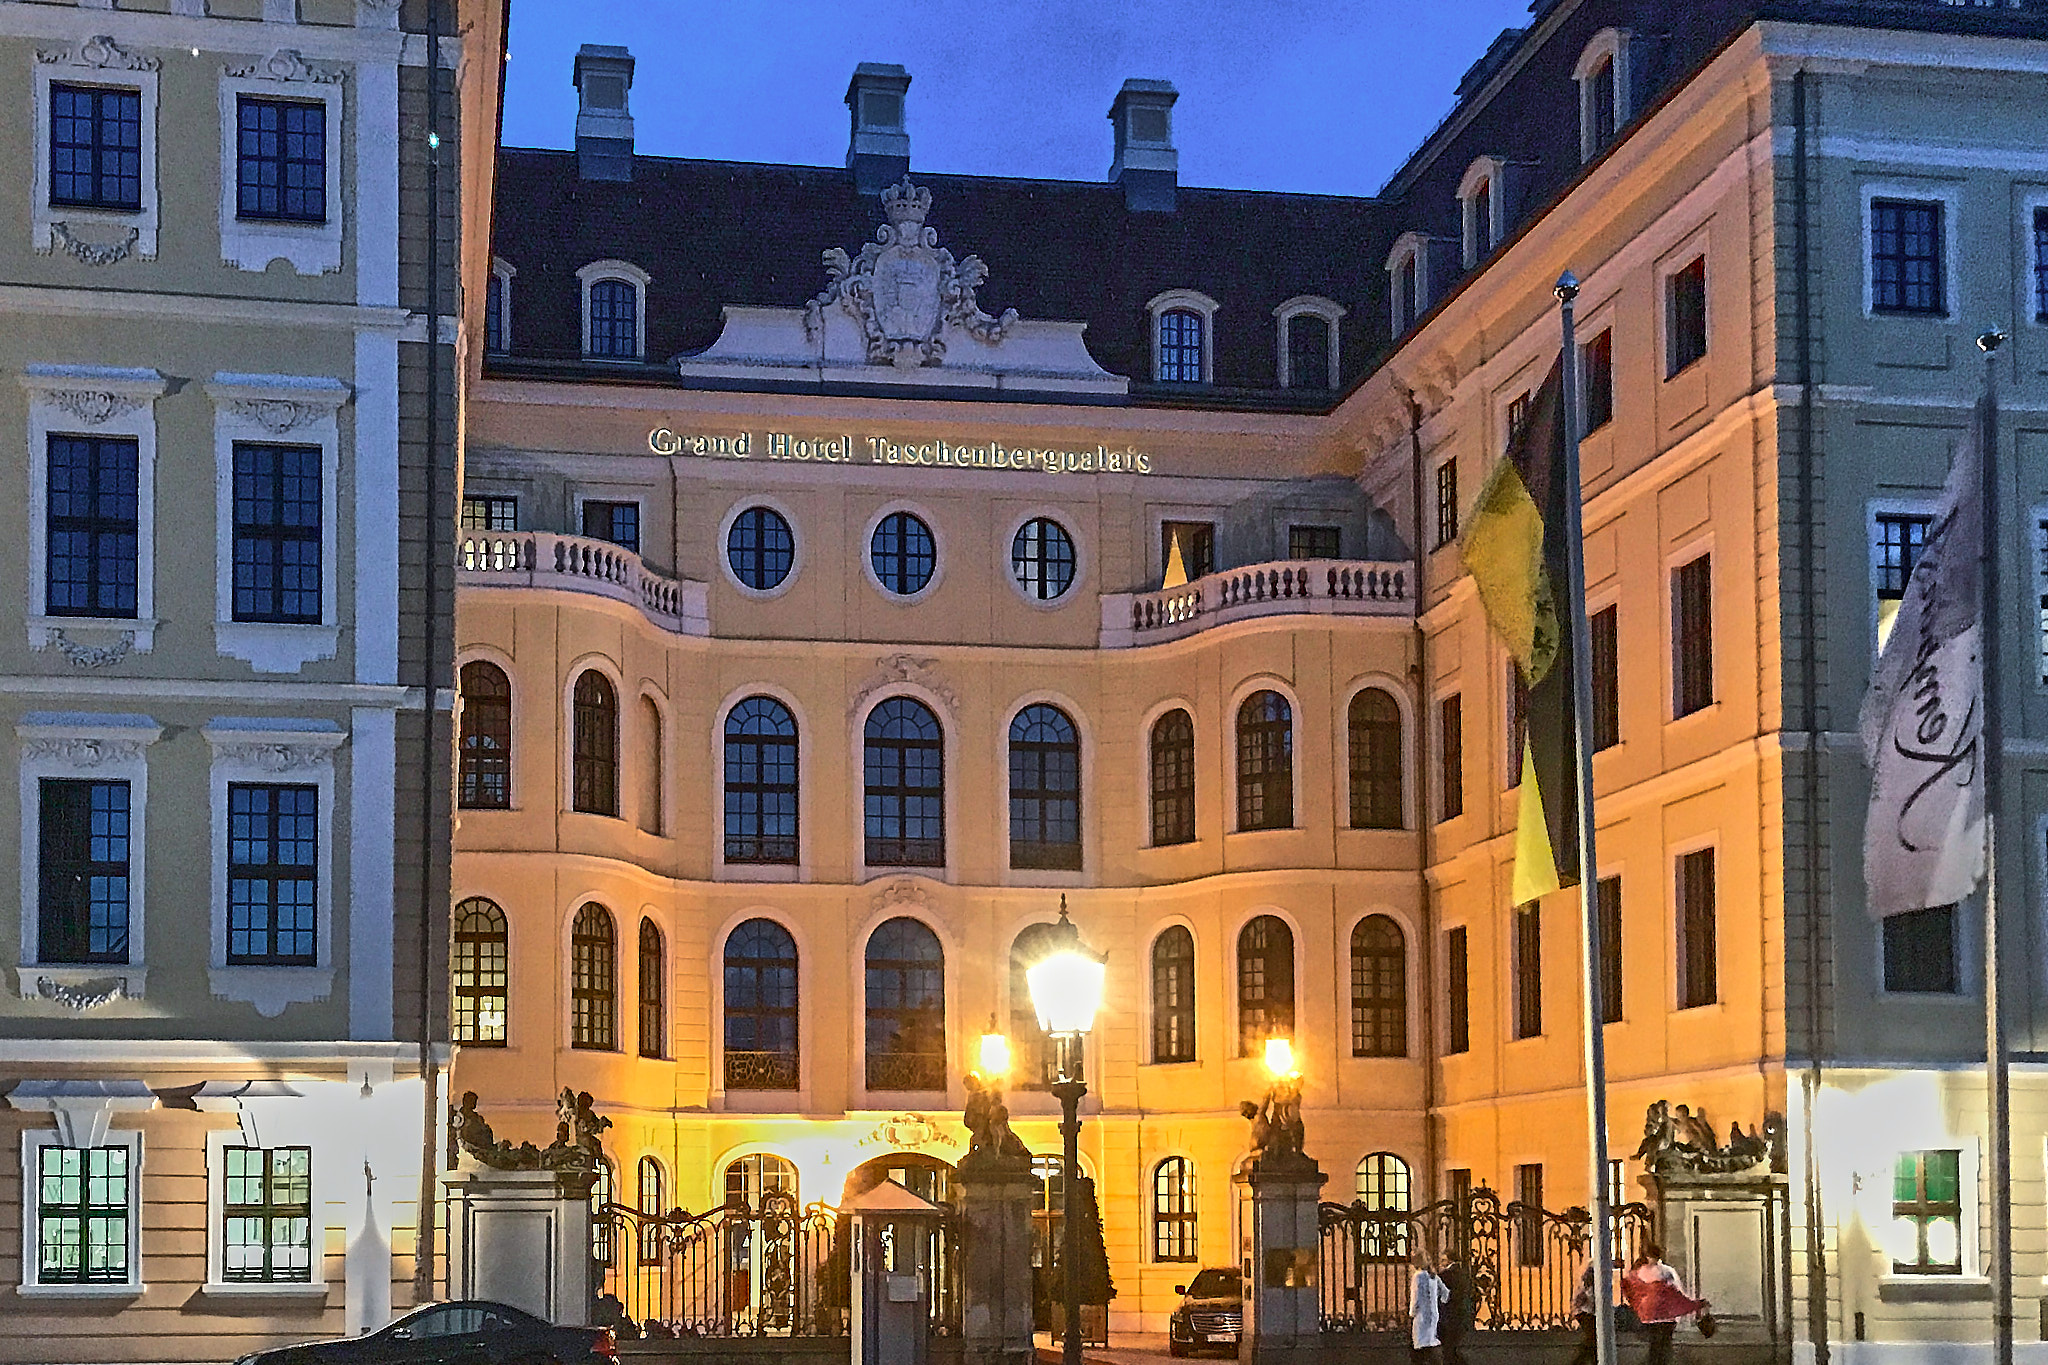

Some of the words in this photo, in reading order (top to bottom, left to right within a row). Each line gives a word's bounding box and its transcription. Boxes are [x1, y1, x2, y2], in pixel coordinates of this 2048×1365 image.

[649, 428, 752, 456] Grand
[767, 433, 852, 462] Hotel
[867, 436, 1151, 473] Taschenbergpalais
